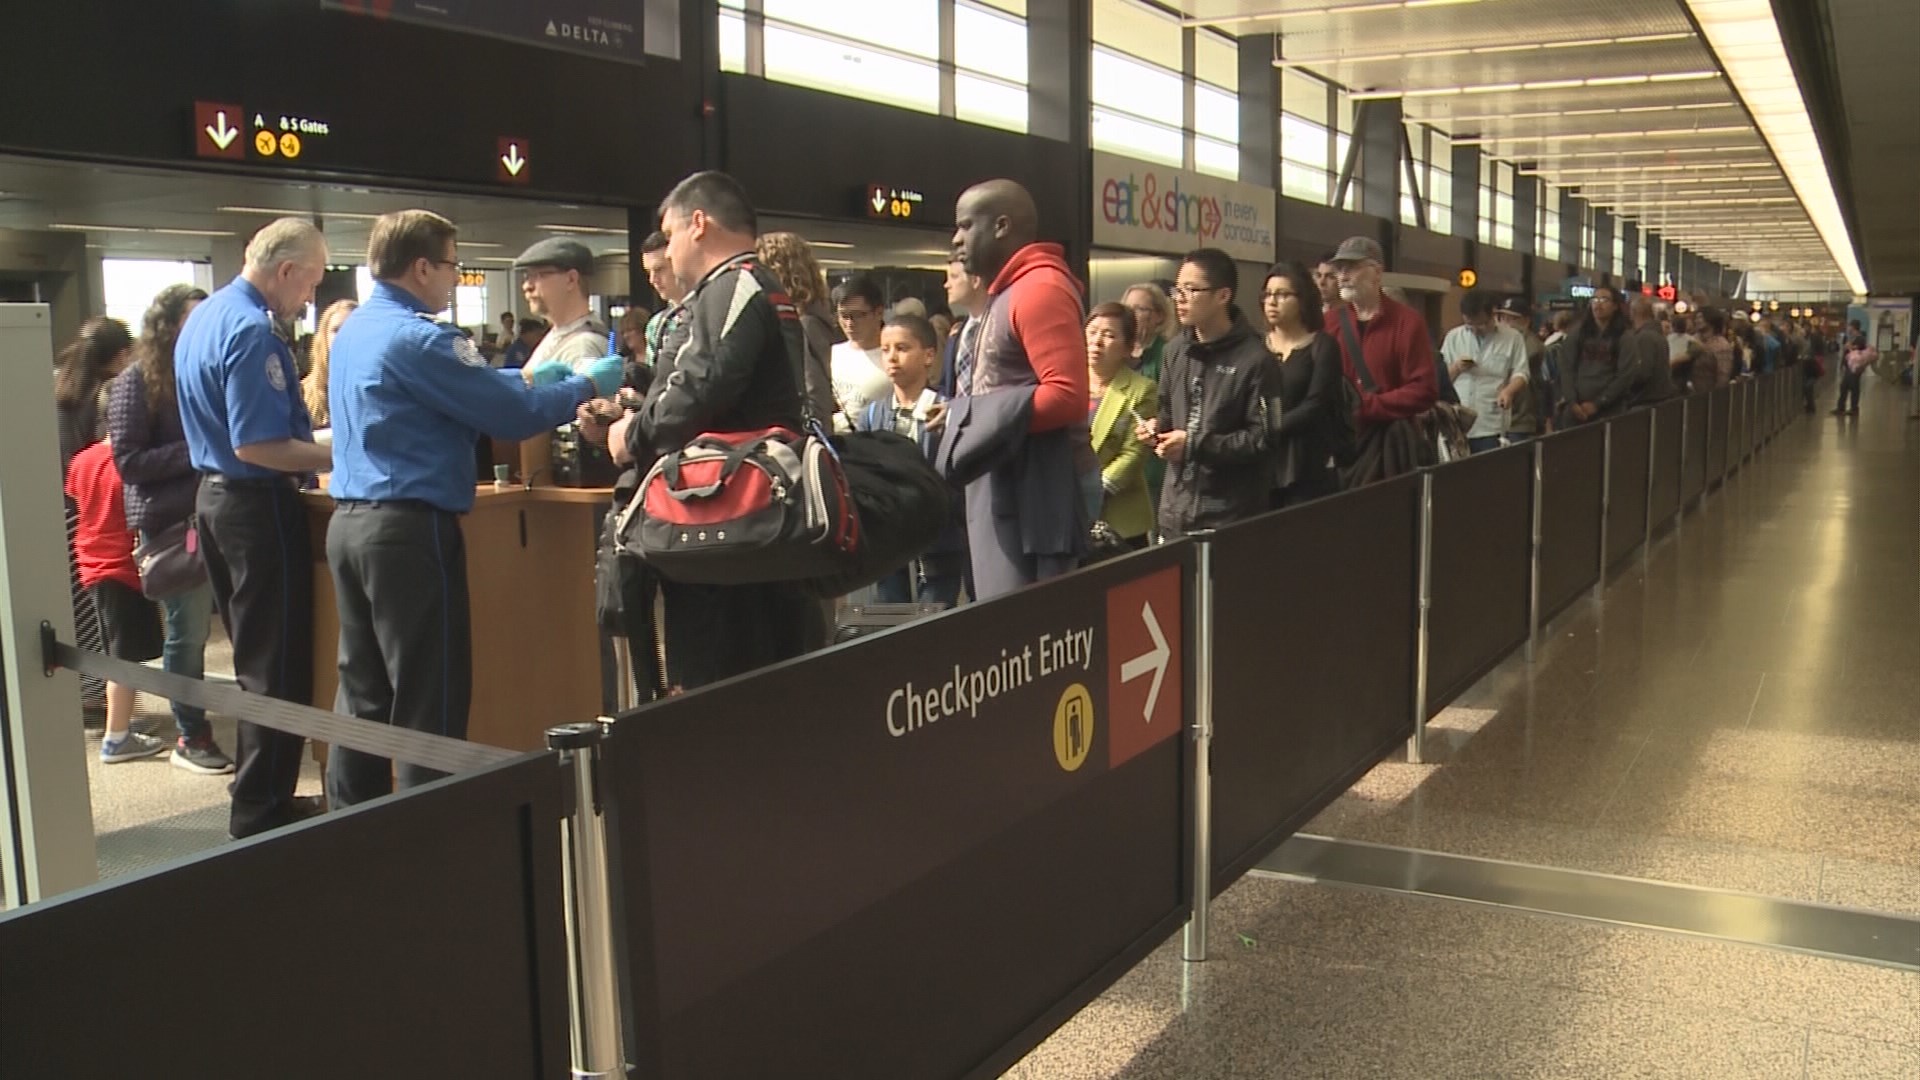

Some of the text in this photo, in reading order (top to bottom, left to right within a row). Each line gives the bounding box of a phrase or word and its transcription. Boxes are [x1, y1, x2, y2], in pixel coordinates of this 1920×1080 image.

[561, 23, 609, 46] DELTA
[254, 113, 329, 135] A & S Gates
[1102, 169, 1212, 248] eat & shop
[1223, 194, 1258, 225] in every
[885, 626, 1095, 738] Checkpoint Entry
